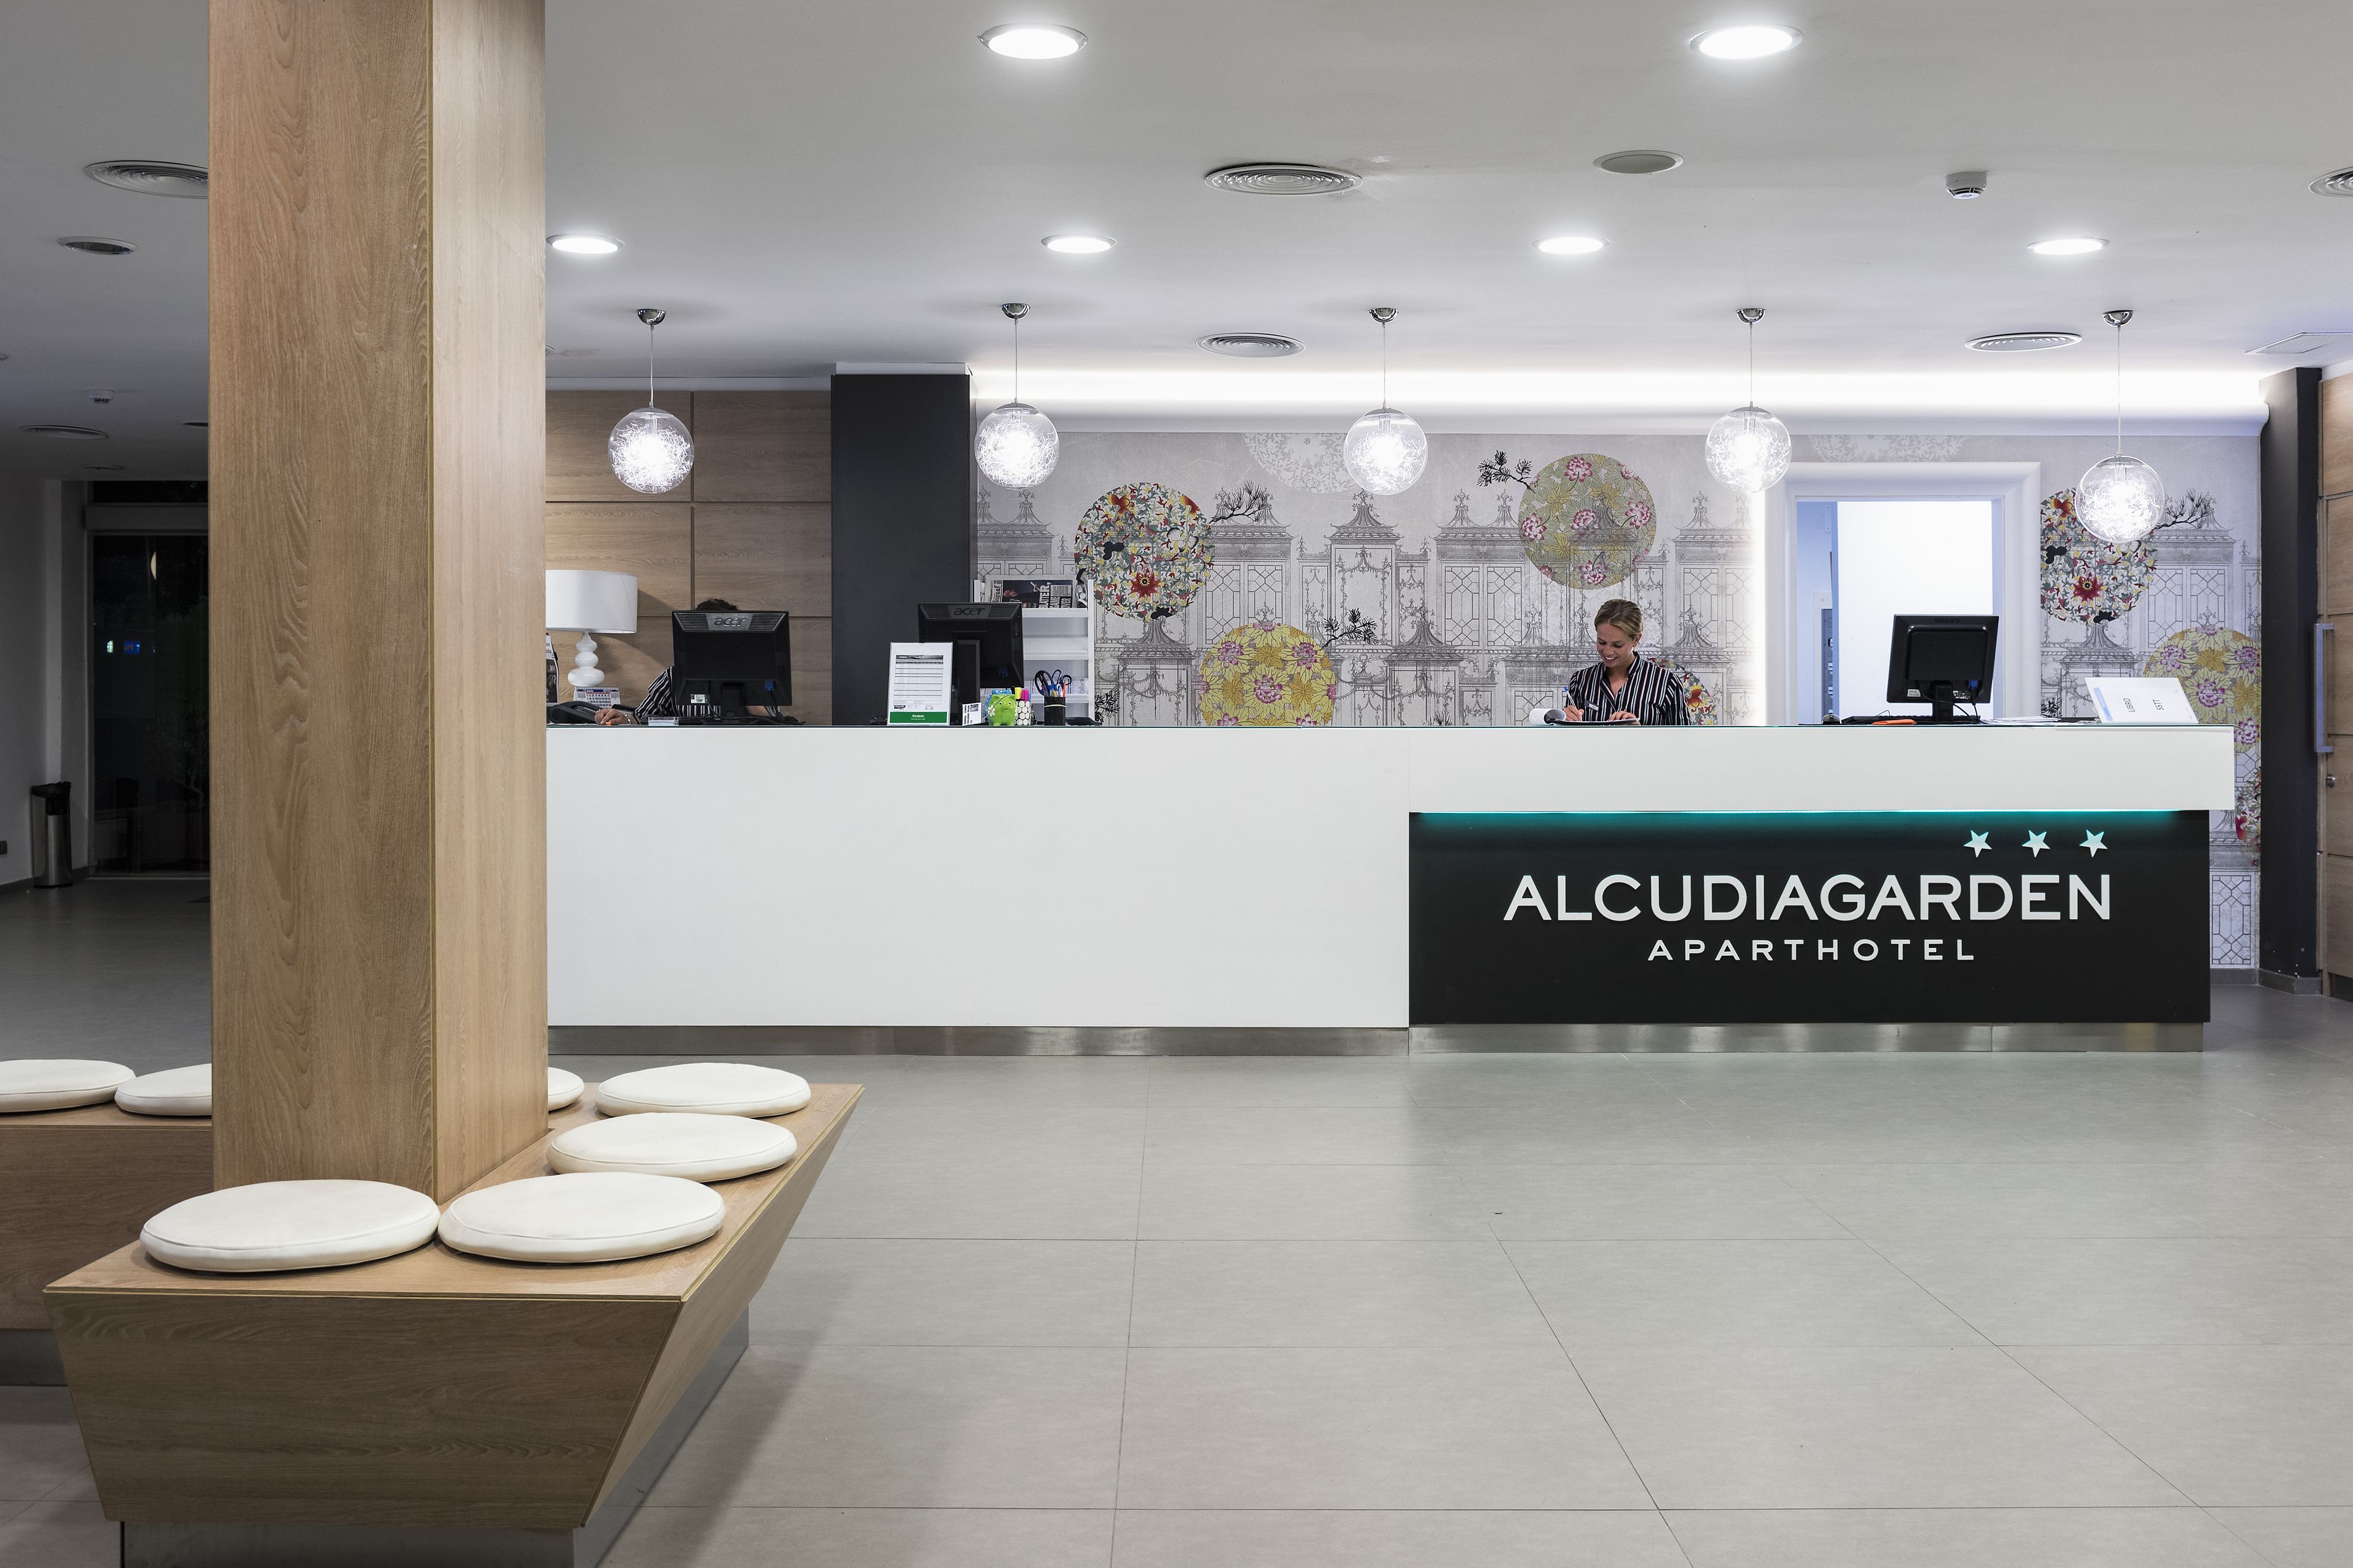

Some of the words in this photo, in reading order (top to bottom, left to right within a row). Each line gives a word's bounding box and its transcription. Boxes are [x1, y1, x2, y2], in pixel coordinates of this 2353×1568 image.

[953, 607, 985, 616] acer
[714, 618, 746, 627] acer
[2123, 697, 2135, 713] LIBRO
[2153, 699, 2164, 711] SSTT
[1503, 874, 2110, 922] ALCUDIAGARDEN
[1647, 939, 1974, 961] APARTHOTEL
